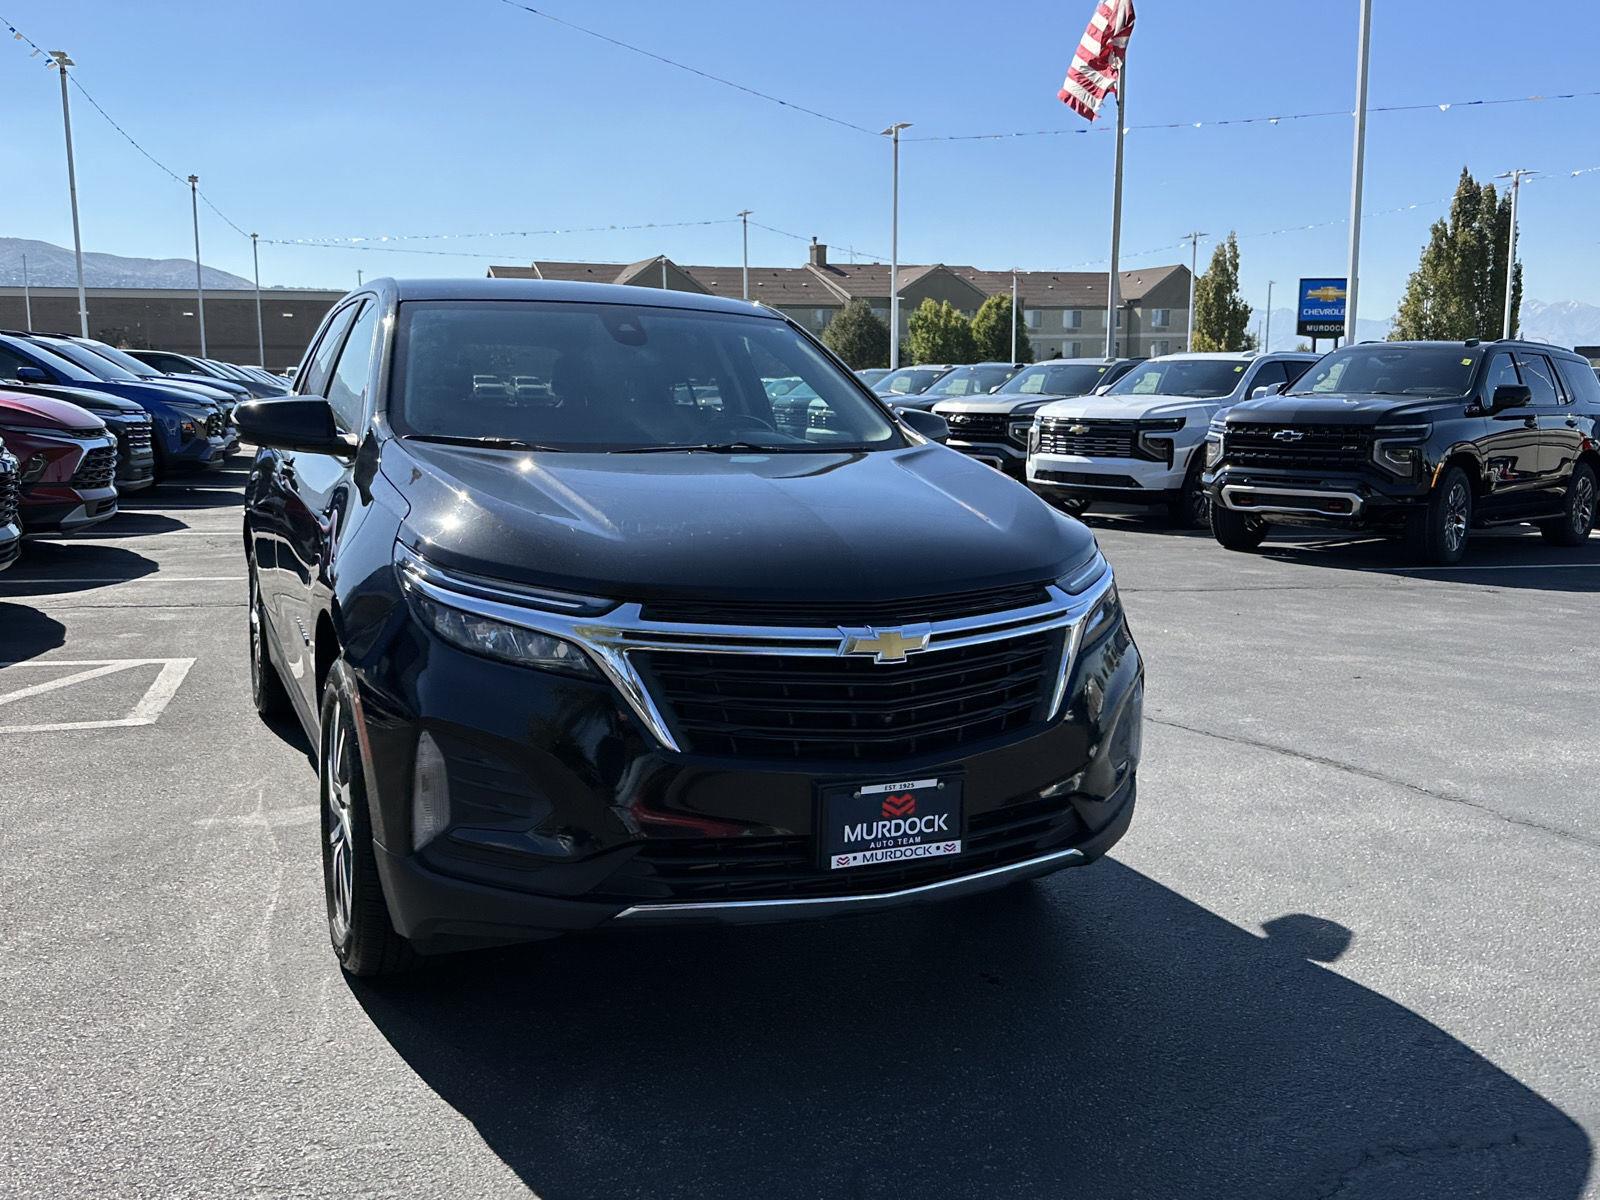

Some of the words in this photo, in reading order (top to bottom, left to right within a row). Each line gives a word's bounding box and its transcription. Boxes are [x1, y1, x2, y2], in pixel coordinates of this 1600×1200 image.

[844, 813, 949, 842] MURDOCK
[870, 839, 894, 849] AUTO
[897, 836, 921, 846] TEAM
[862, 845, 933, 863] MURDOCK
